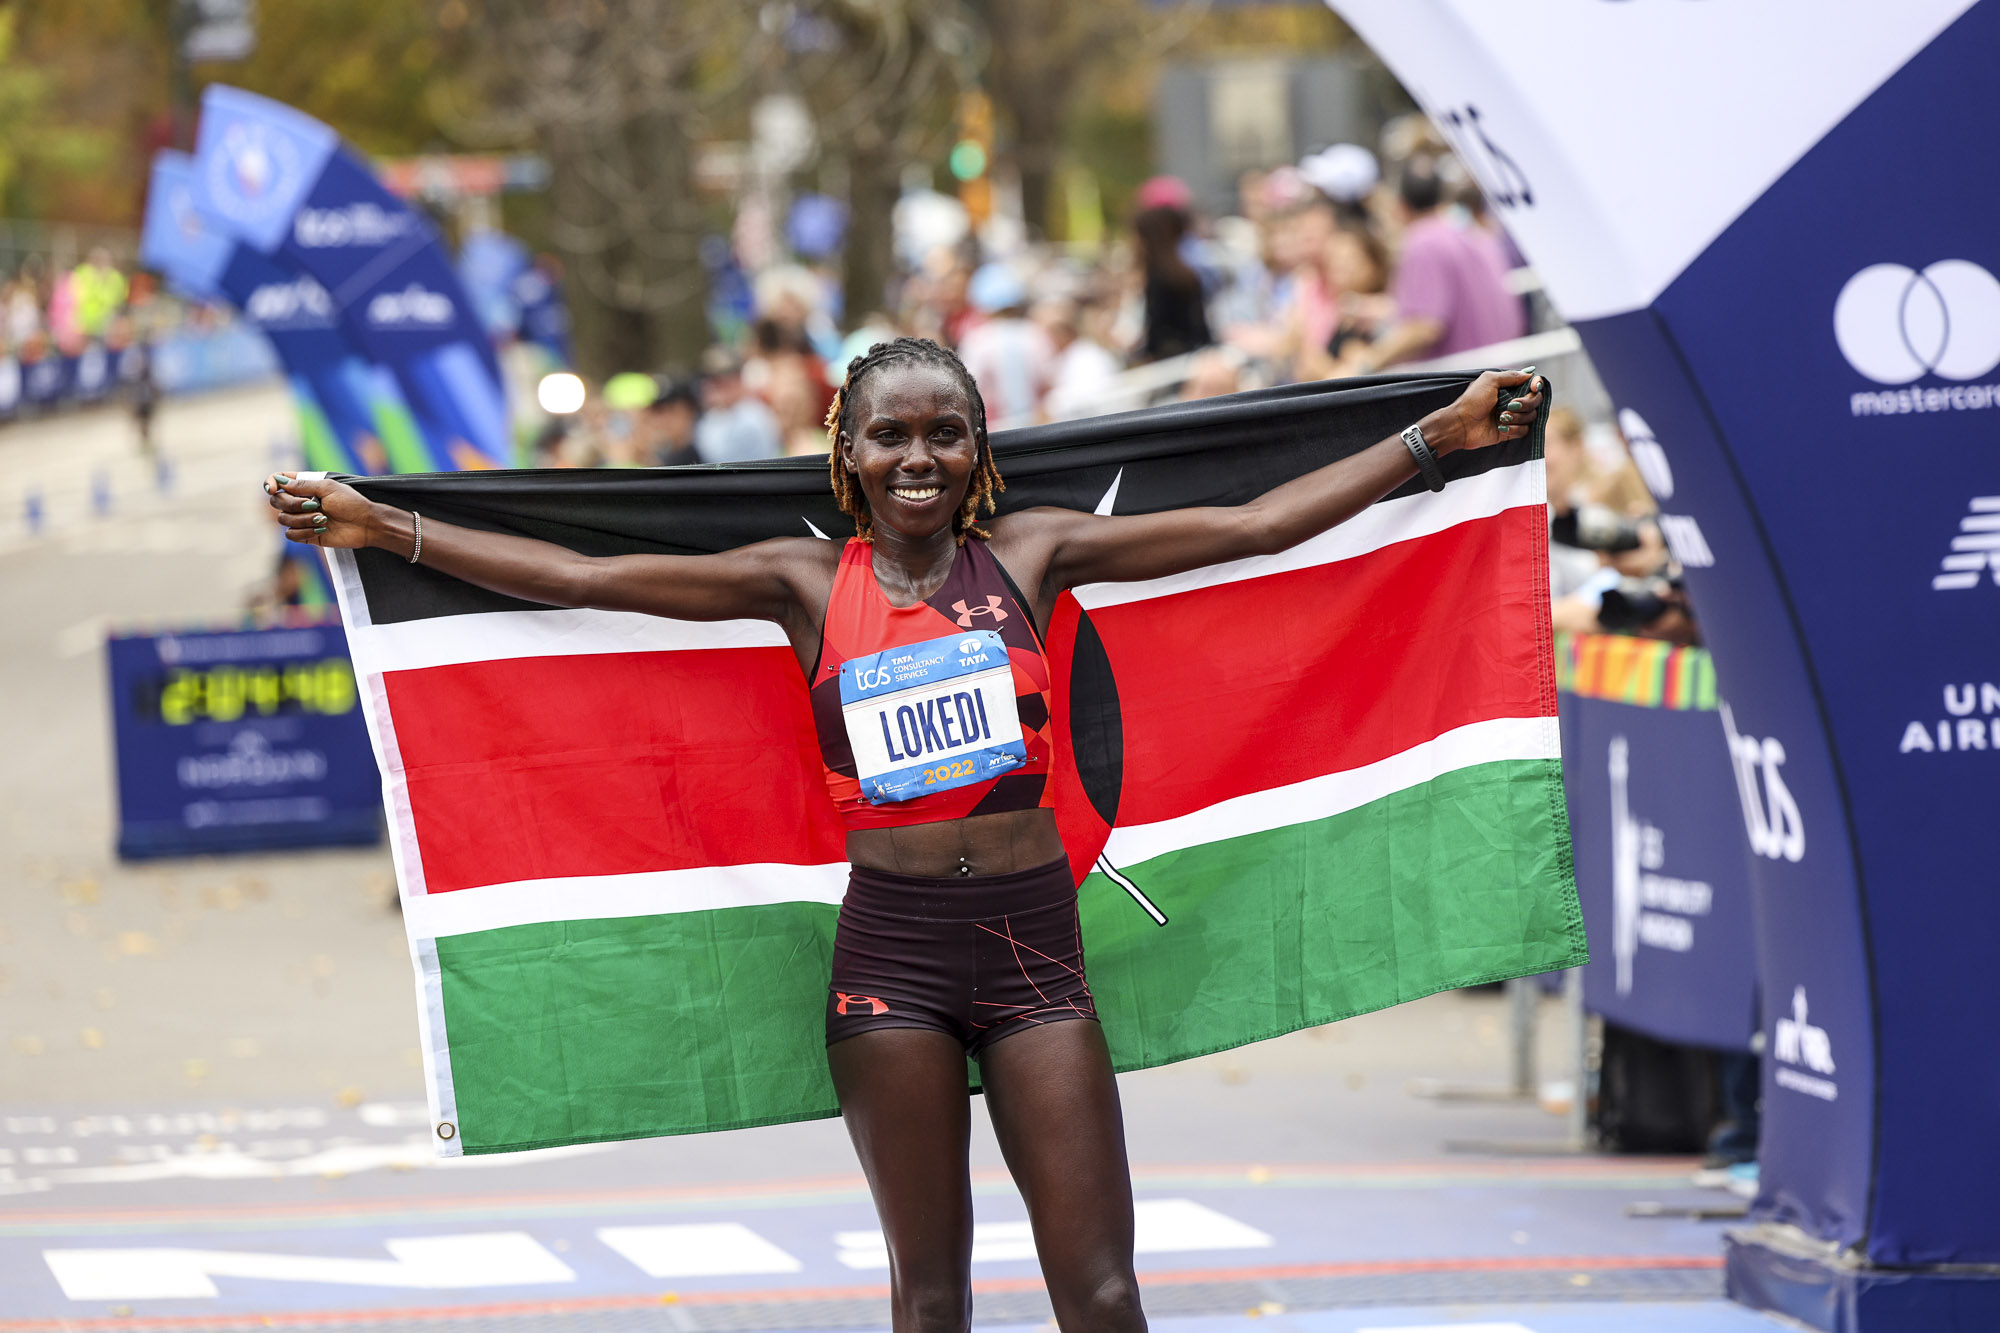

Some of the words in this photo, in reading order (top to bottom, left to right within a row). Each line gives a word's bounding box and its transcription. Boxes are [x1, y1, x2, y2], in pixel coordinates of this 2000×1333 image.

[891, 655, 914, 666] TATA
[893, 656, 945, 674] CONSULTANCY
[958, 653, 989, 668] TATA
[855, 665, 891, 691] tcs
[895, 668, 929, 682] SERVICES
[879, 688, 992, 762] LOKEDI
[923, 759, 976, 785] 2022
